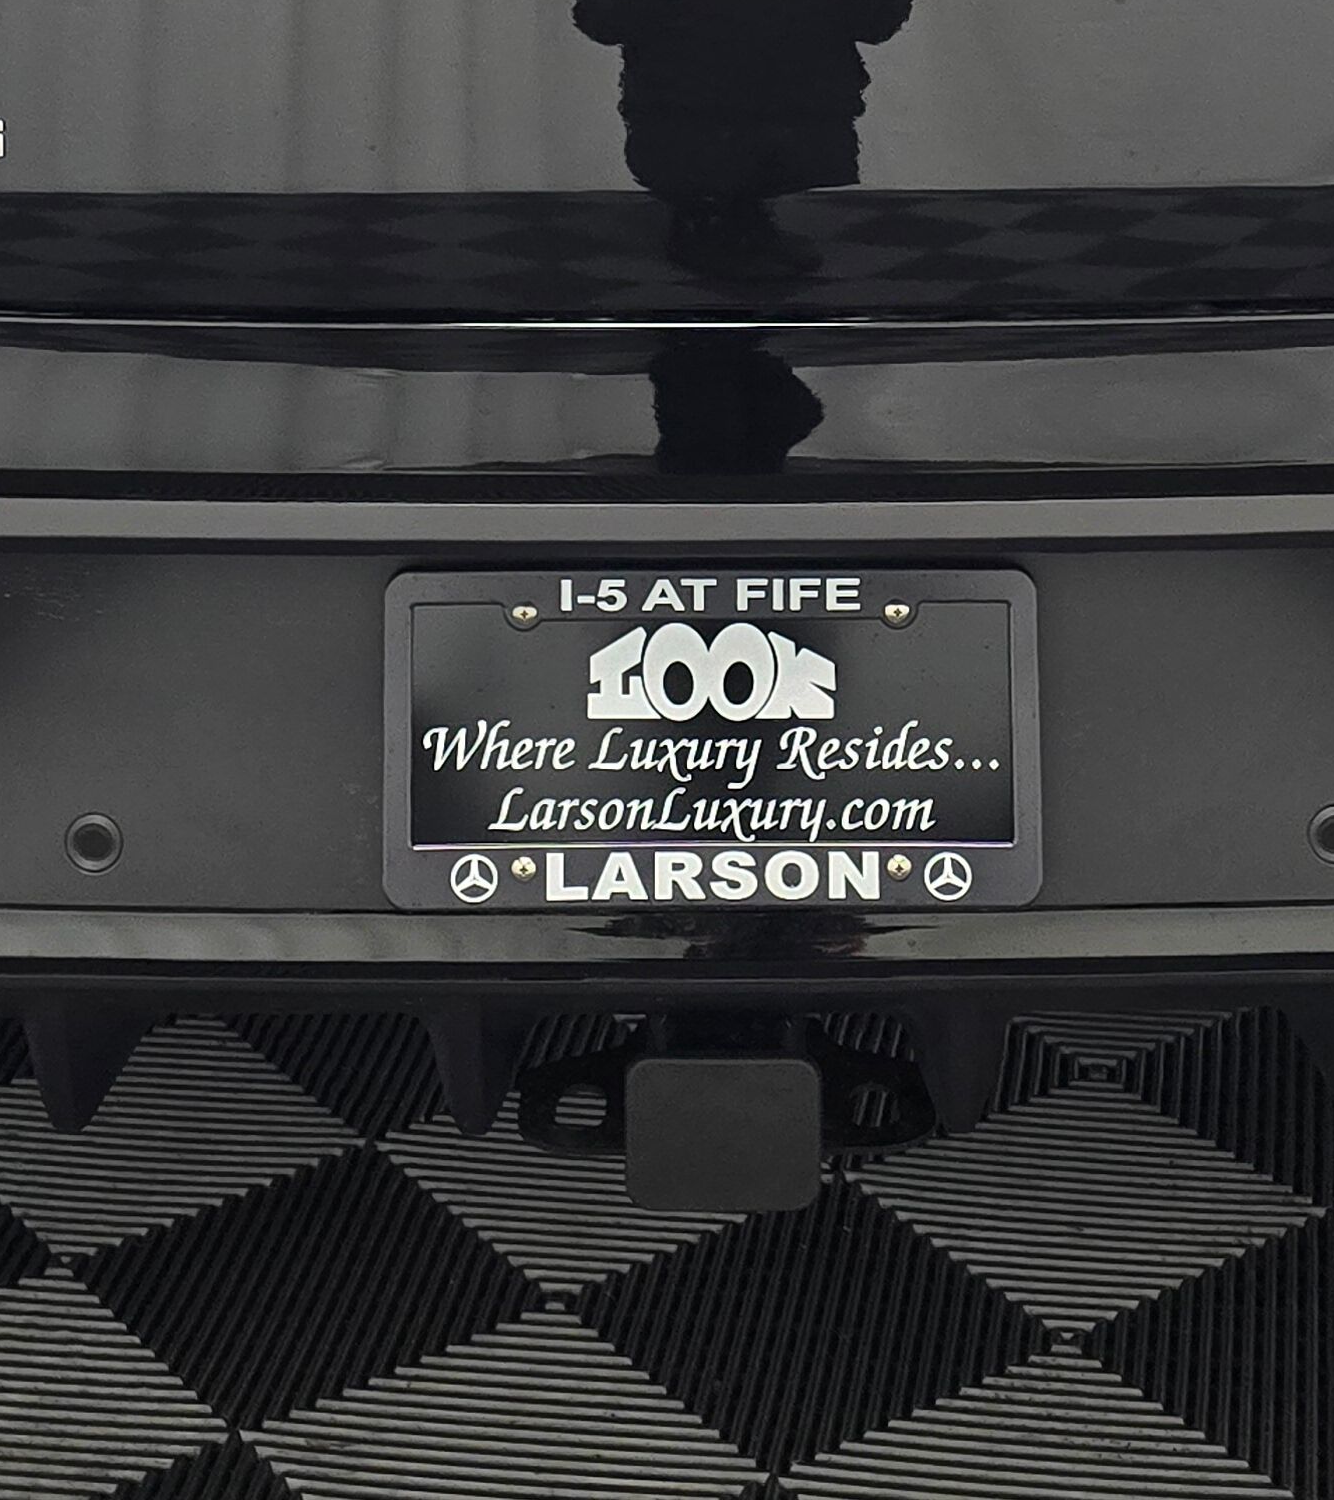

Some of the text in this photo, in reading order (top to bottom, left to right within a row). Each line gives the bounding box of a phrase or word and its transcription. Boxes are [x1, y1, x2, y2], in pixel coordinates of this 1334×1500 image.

[560, 577, 861, 612] I-5 AT FIFE
[586, 622, 837, 722] LOOK
[422, 719, 1000, 790] Where Luxury Resides...
[487, 786, 936, 843] LarsonLuxury.com
[544, 850, 881, 902] LARSON
